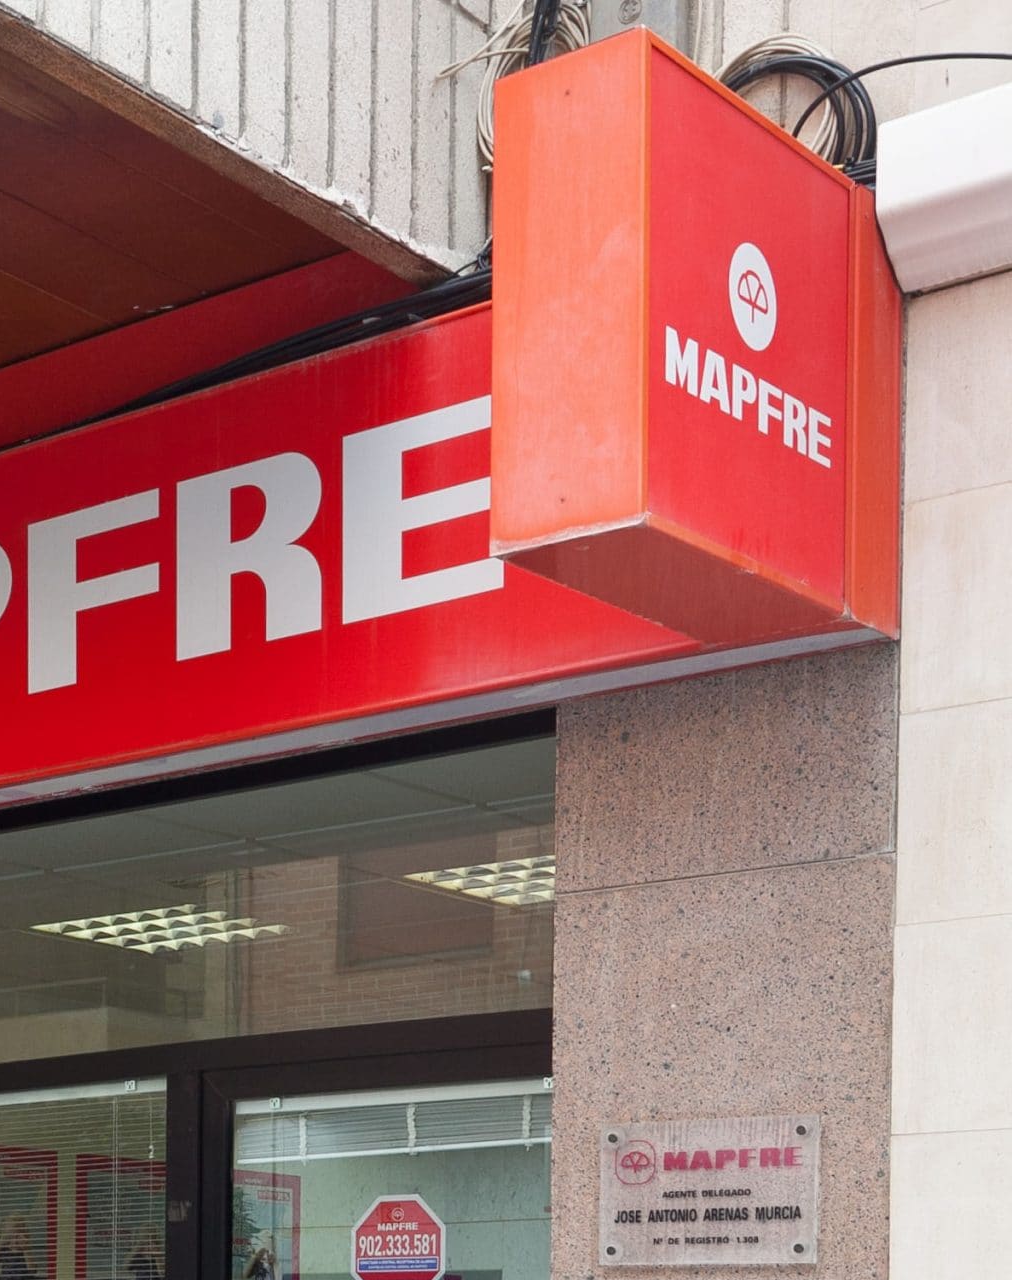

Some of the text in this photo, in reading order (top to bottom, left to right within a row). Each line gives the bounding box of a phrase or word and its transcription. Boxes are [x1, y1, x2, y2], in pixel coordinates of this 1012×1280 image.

[665, 325, 831, 469] MAPFRE
[663, 1146, 803, 1171] MAPFRE
[662, 1188, 752, 1199] AGENTE DELEGADO
[614, 1205, 802, 1224] JOSE ANTONIO ARENAS MURCIA
[377, 1222, 419, 1232] MAPFRE
[359, 1233, 437, 1256] 902.333.581
[668, 1237, 680, 1245] DE
[685, 1236, 730, 1245] REGISTRO
